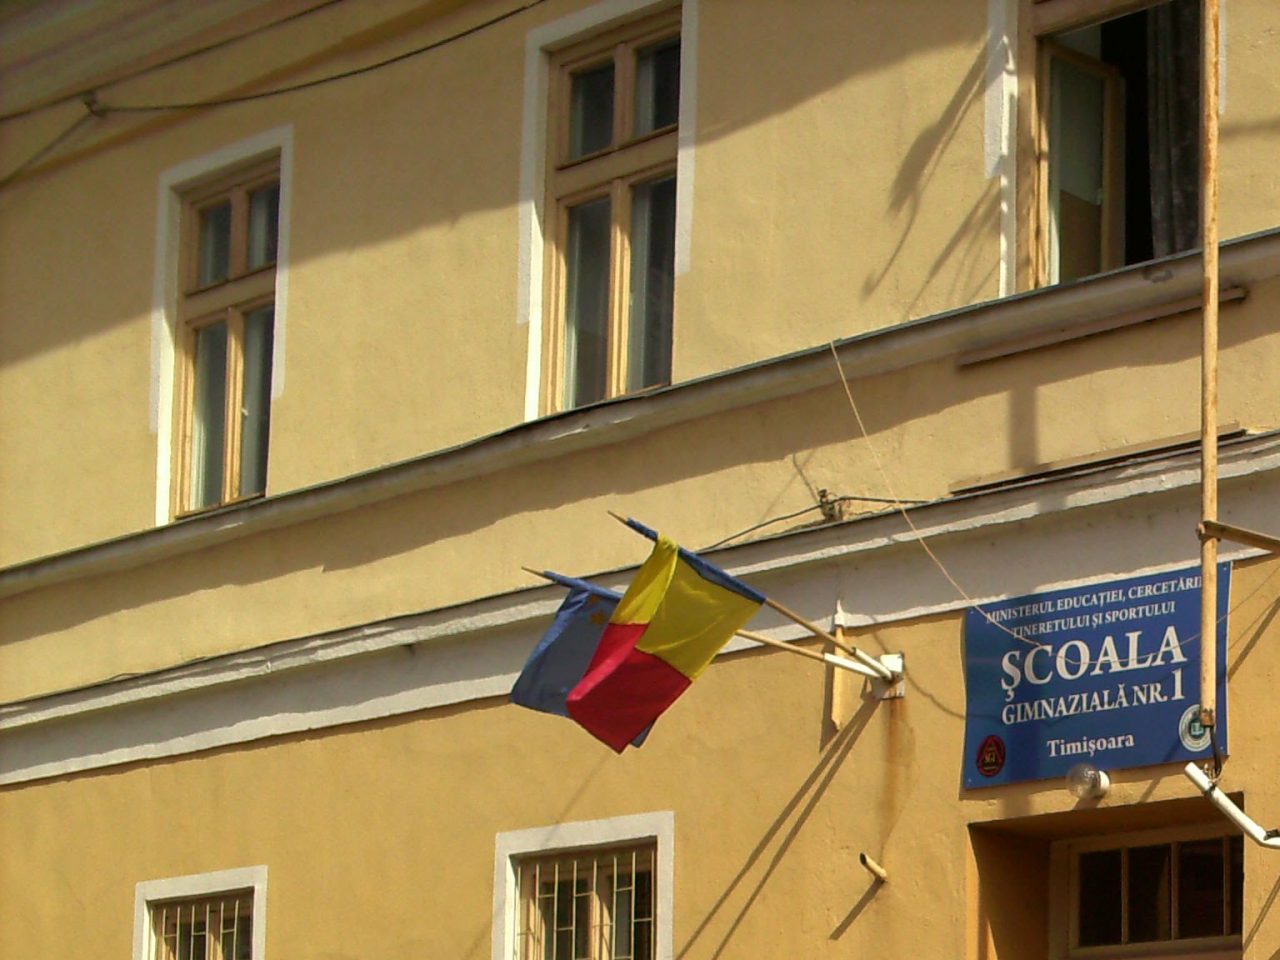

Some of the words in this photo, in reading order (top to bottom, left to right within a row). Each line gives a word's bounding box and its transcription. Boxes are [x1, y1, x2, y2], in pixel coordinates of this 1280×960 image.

[986, 601, 1056, 624] MINISTERUL
[1013, 616, 1090, 639] TINERETULUI
[1104, 601, 1176, 622] SPORTULUI
[1001, 682, 1128, 726] GIMNAZIALĂ
